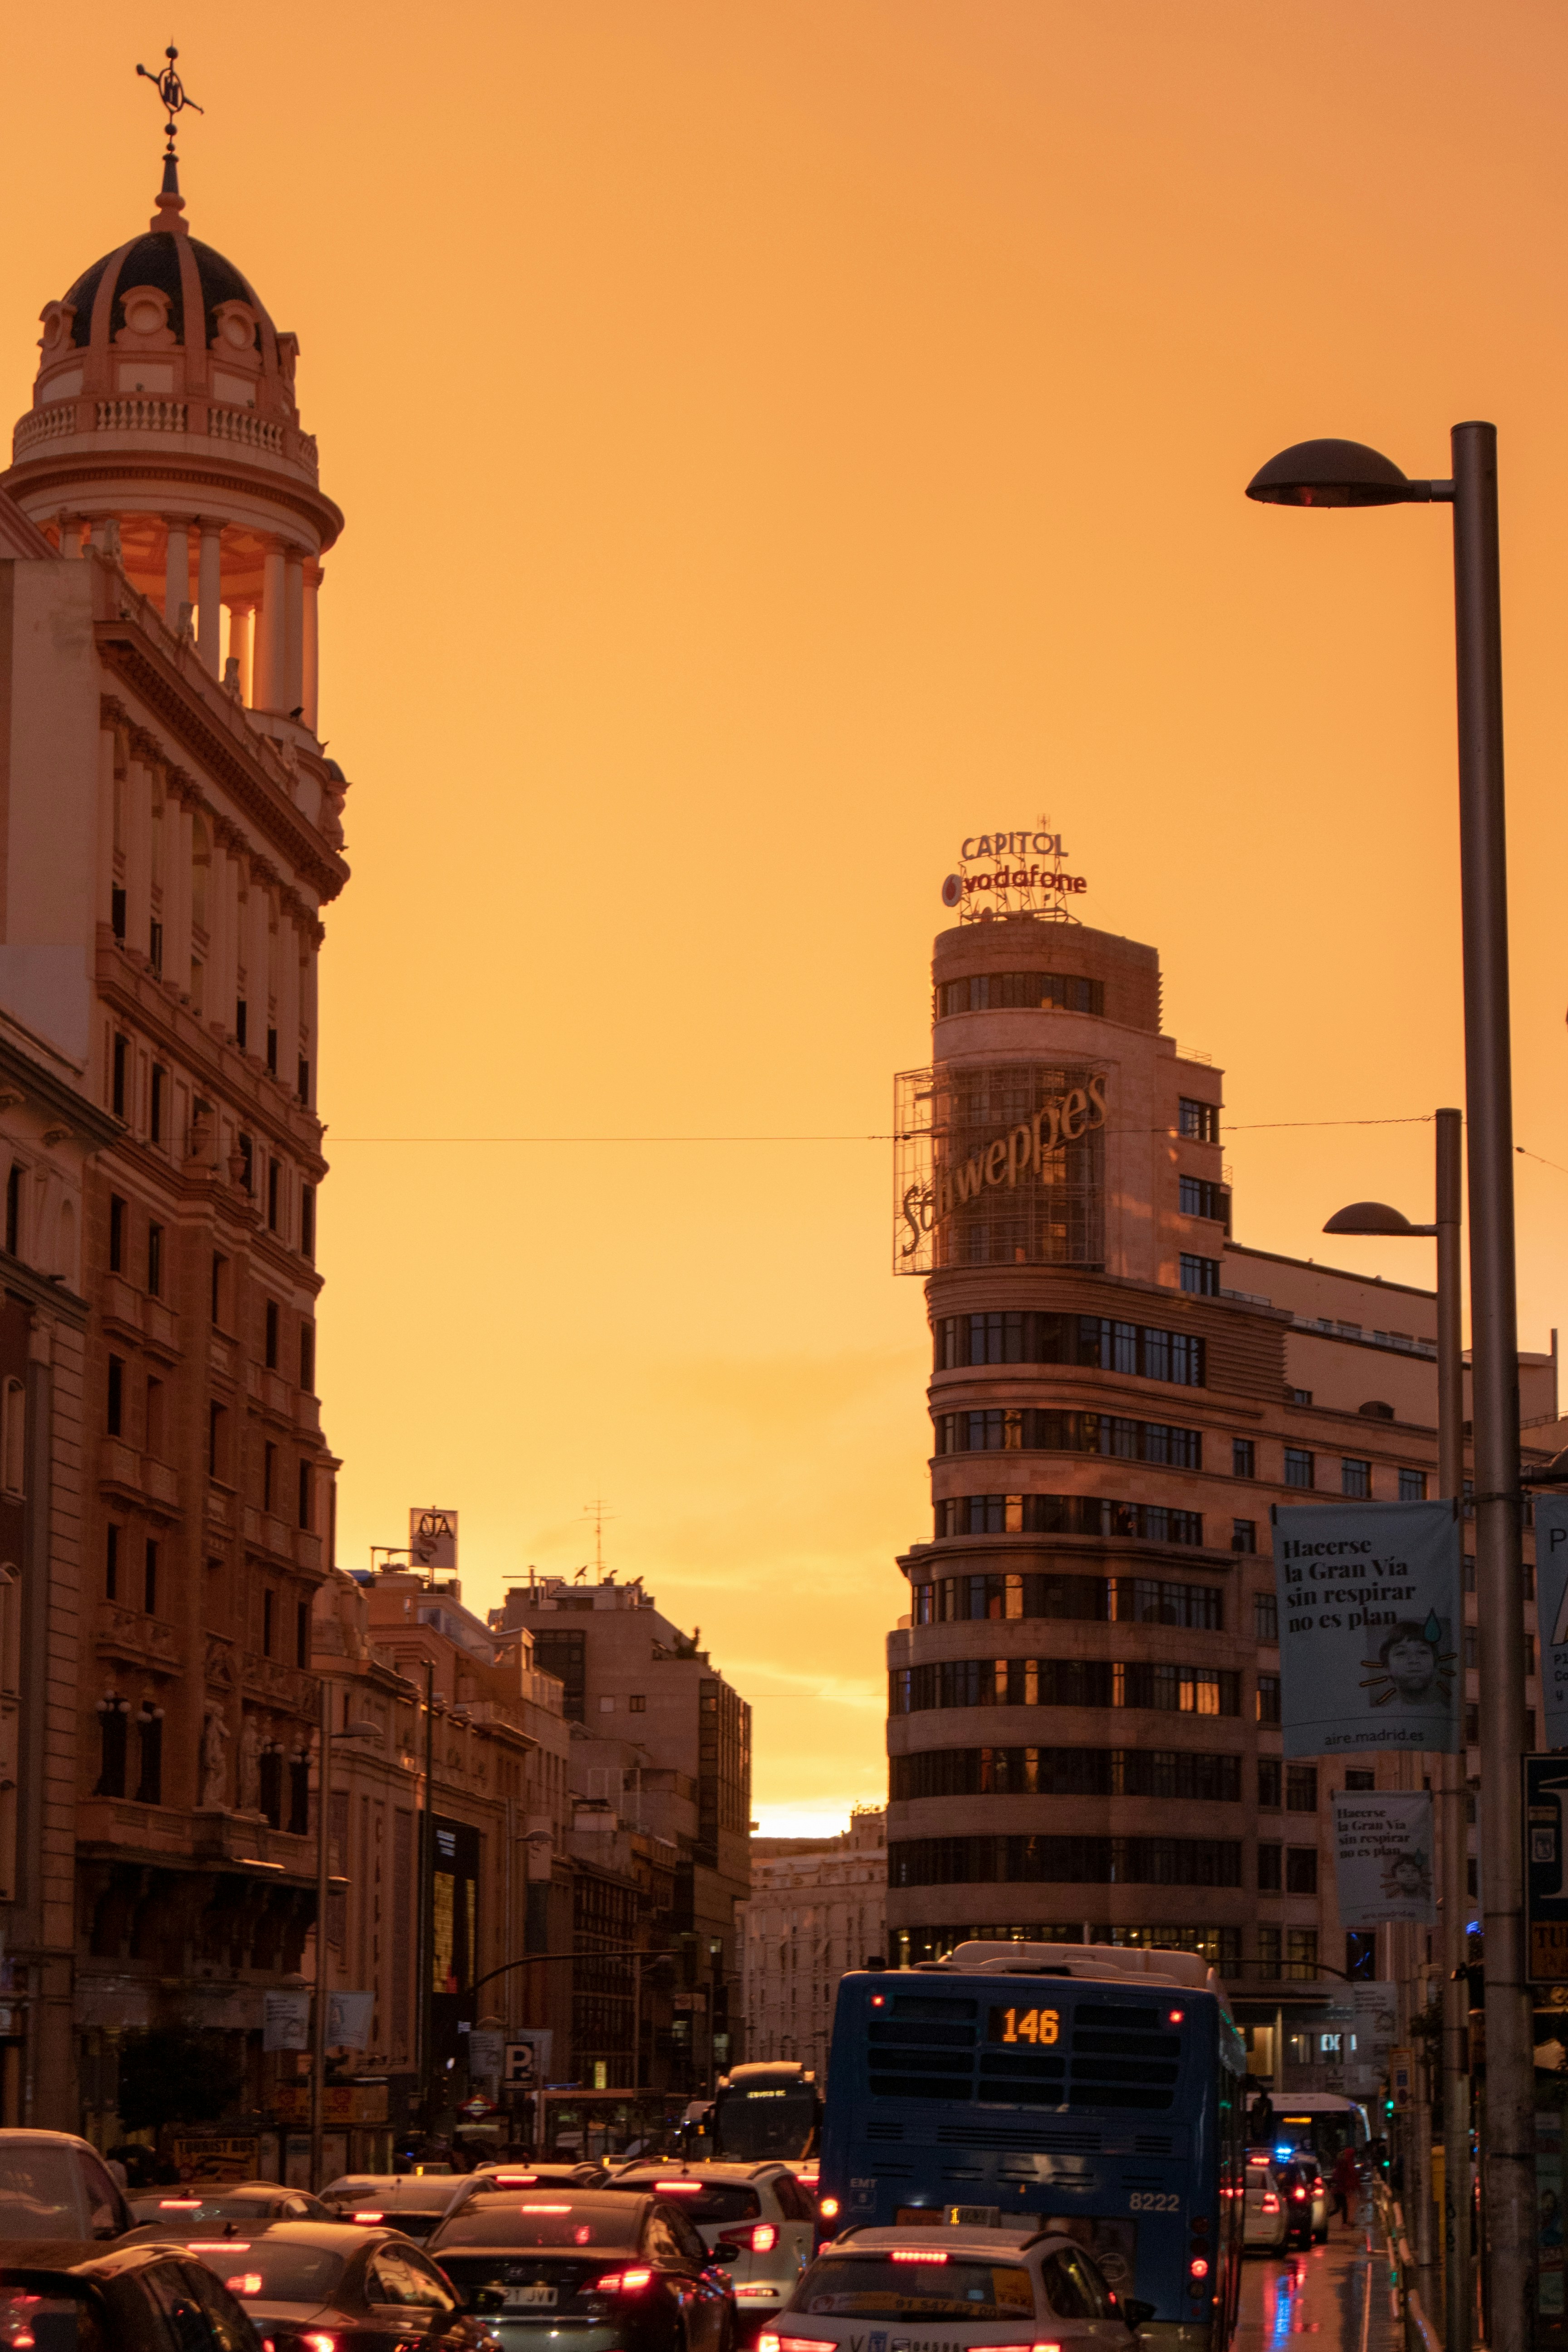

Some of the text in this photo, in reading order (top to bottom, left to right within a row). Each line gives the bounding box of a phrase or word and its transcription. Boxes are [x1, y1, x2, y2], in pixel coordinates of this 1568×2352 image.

[961, 832, 1068, 860] CAPITOL
[964, 864, 1087, 893] vodafone
[902, 1072, 1107, 1258] Schweppes
[1284, 1540, 1372, 1559] Hacerse
[1284, 1556, 1408, 1583] la Gran Vía
[1287, 1582, 1416, 1608] sin respirar
[1289, 1607, 1397, 1633] no es plan
[1324, 1729, 1424, 1745] aire.madrid.es
[1338, 1808, 1386, 1818] Hacerse
[1338, 1821, 1348, 1832] la
[1352, 1820, 1383, 1830] Gran
[1339, 1832, 1410, 1845] sin respirar
[1340, 1848, 1354, 1858] no
[1374, 1845, 1401, 1857] plan
[1534, 1926, 1568, 1948] TU
[1003, 2007, 1060, 2045] 146
[179, 2140, 255, 2153] TOURIST BUS
[850, 2178, 878, 2188] EMT
[1129, 2192, 1180, 2211] 8222
